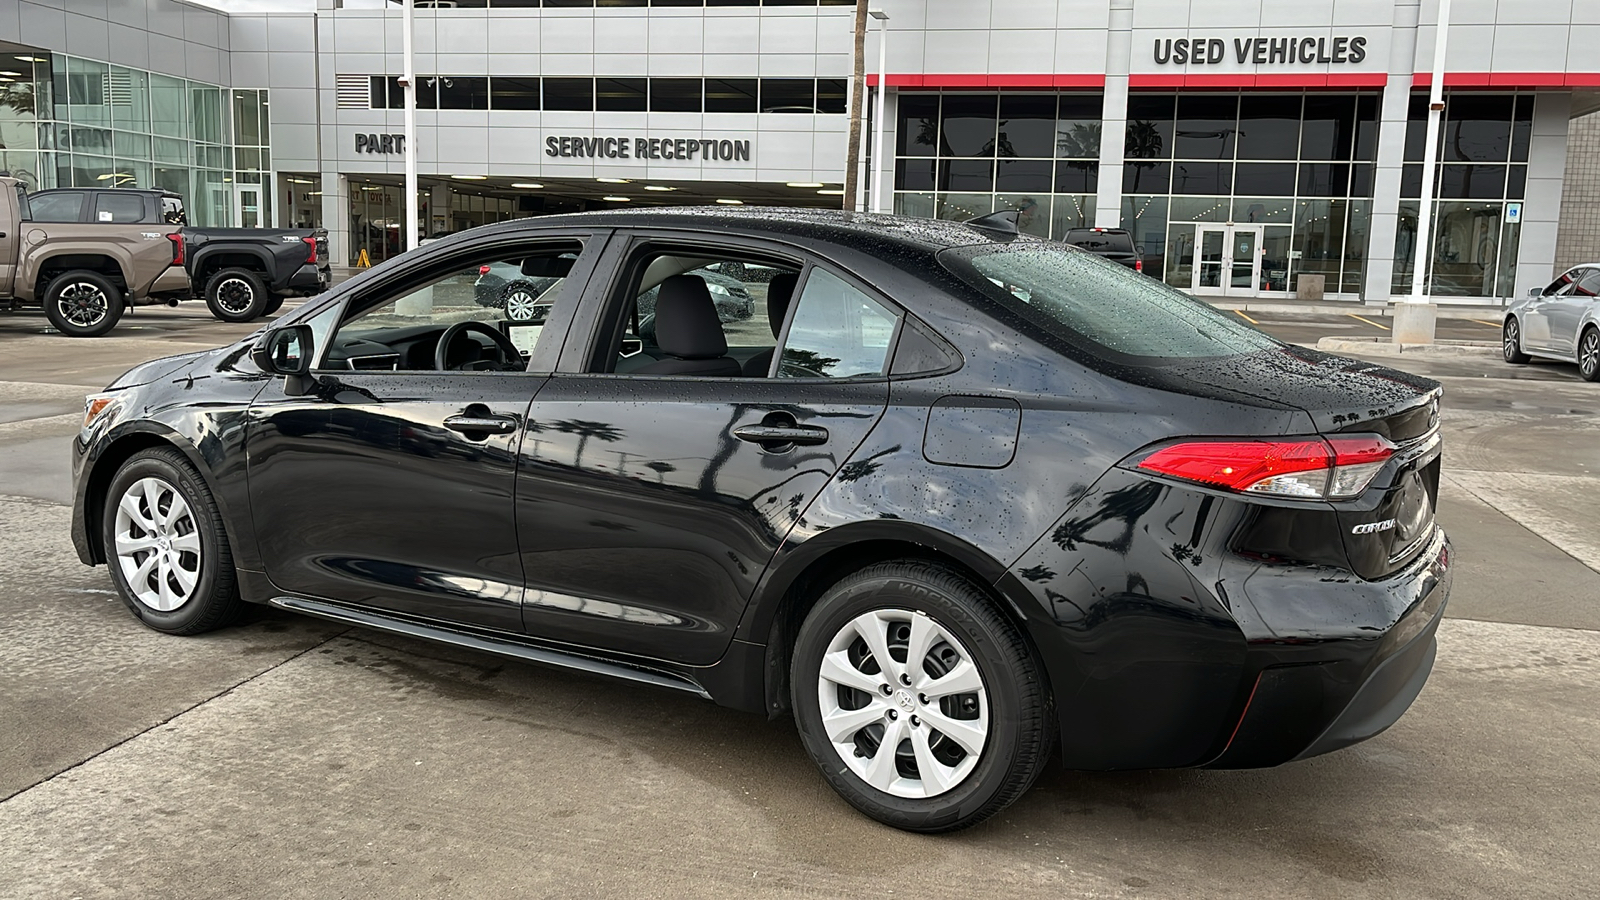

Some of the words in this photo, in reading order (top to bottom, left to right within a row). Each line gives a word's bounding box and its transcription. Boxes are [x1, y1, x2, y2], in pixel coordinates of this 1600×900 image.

[1153, 38, 1225, 65] USED
[1233, 36, 1368, 65] VEHICLES
[354, 133, 419, 154] PART
[545, 136, 630, 159] SERVICE
[634, 137, 750, 161] RECEPTION
[898, 582, 975, 624] KINERGY
